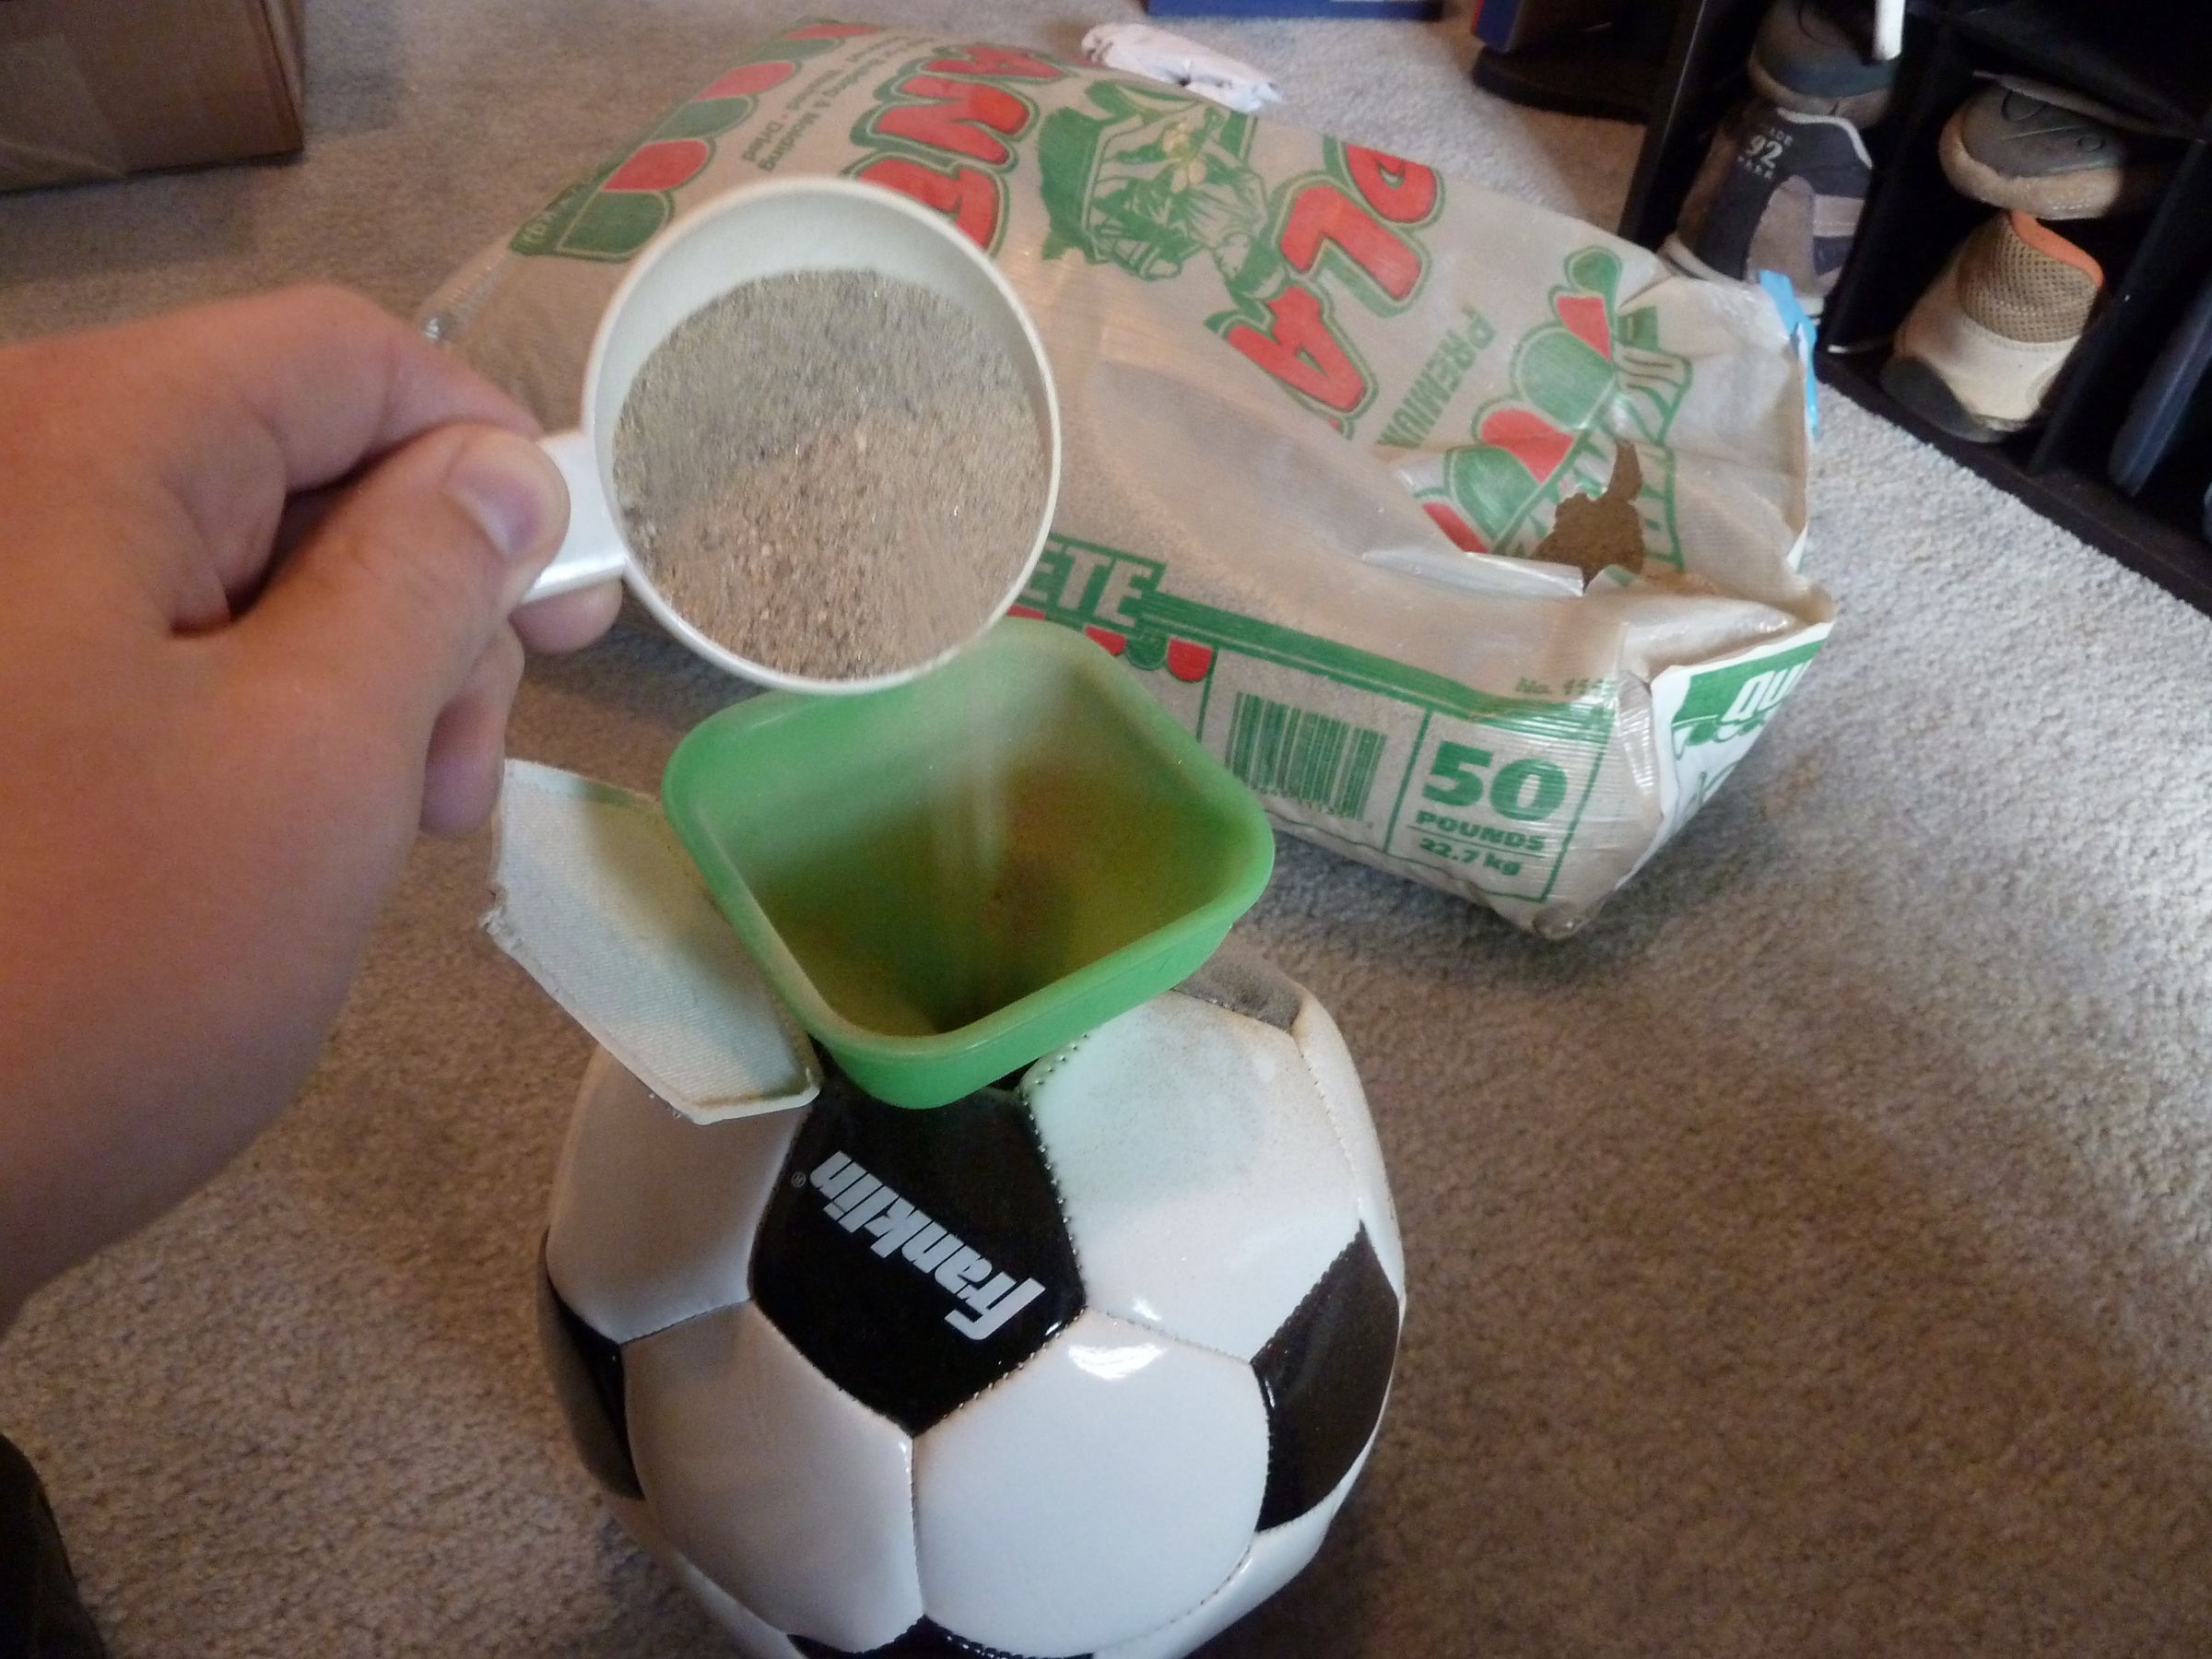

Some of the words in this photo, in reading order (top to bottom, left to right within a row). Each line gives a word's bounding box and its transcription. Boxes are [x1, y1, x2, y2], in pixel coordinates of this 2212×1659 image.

[1745, 134, 1783, 171] 92
[1203, 135, 1445, 441] PLA
[1422, 740, 1568, 822] 50
[1416, 810, 1548, 851] POUNDS
[1419, 837, 1480, 864] 22.7
[1483, 852, 1523, 877] kg
